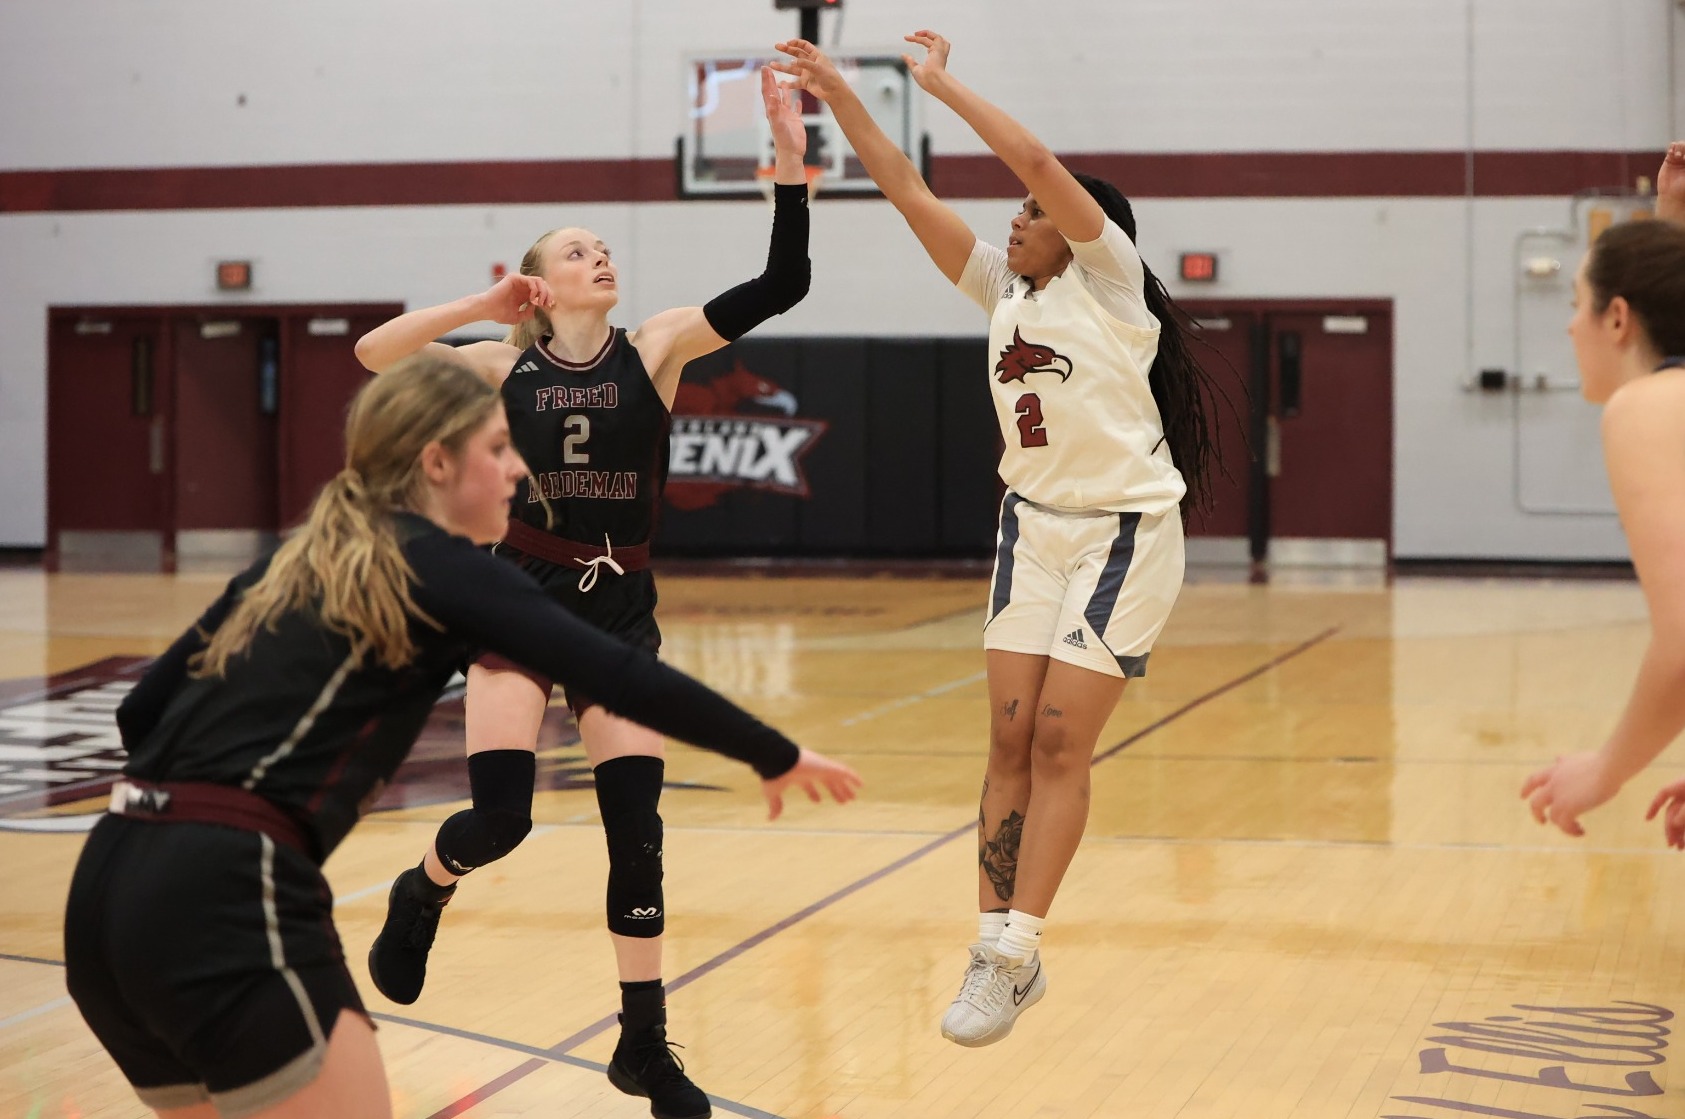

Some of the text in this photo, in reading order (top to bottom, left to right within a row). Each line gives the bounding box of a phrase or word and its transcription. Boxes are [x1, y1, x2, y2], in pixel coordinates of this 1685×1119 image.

[536, 383, 618, 411] FREED
[1015, 393, 1049, 448] 2
[563, 414, 590, 464] 2
[1062, 636, 1088, 650] adidas
[1418, 1000, 1675, 1096] Ellis
